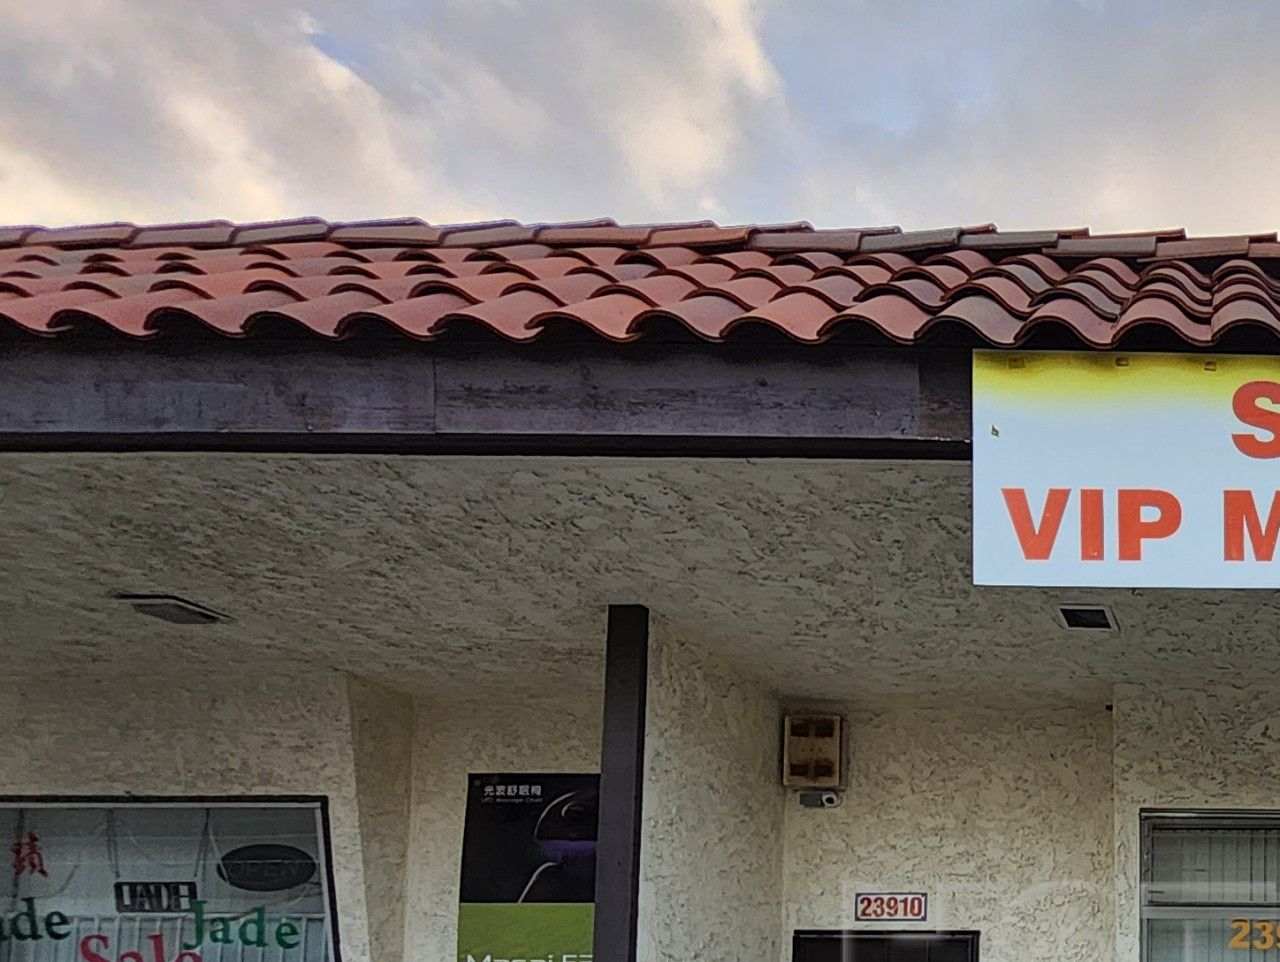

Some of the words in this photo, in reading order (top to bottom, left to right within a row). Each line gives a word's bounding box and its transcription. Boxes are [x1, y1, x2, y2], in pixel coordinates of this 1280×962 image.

[1001, 488, 1182, 562] VIP
[183, 900, 301, 950] Jade
[859, 896, 923, 918] 23910
